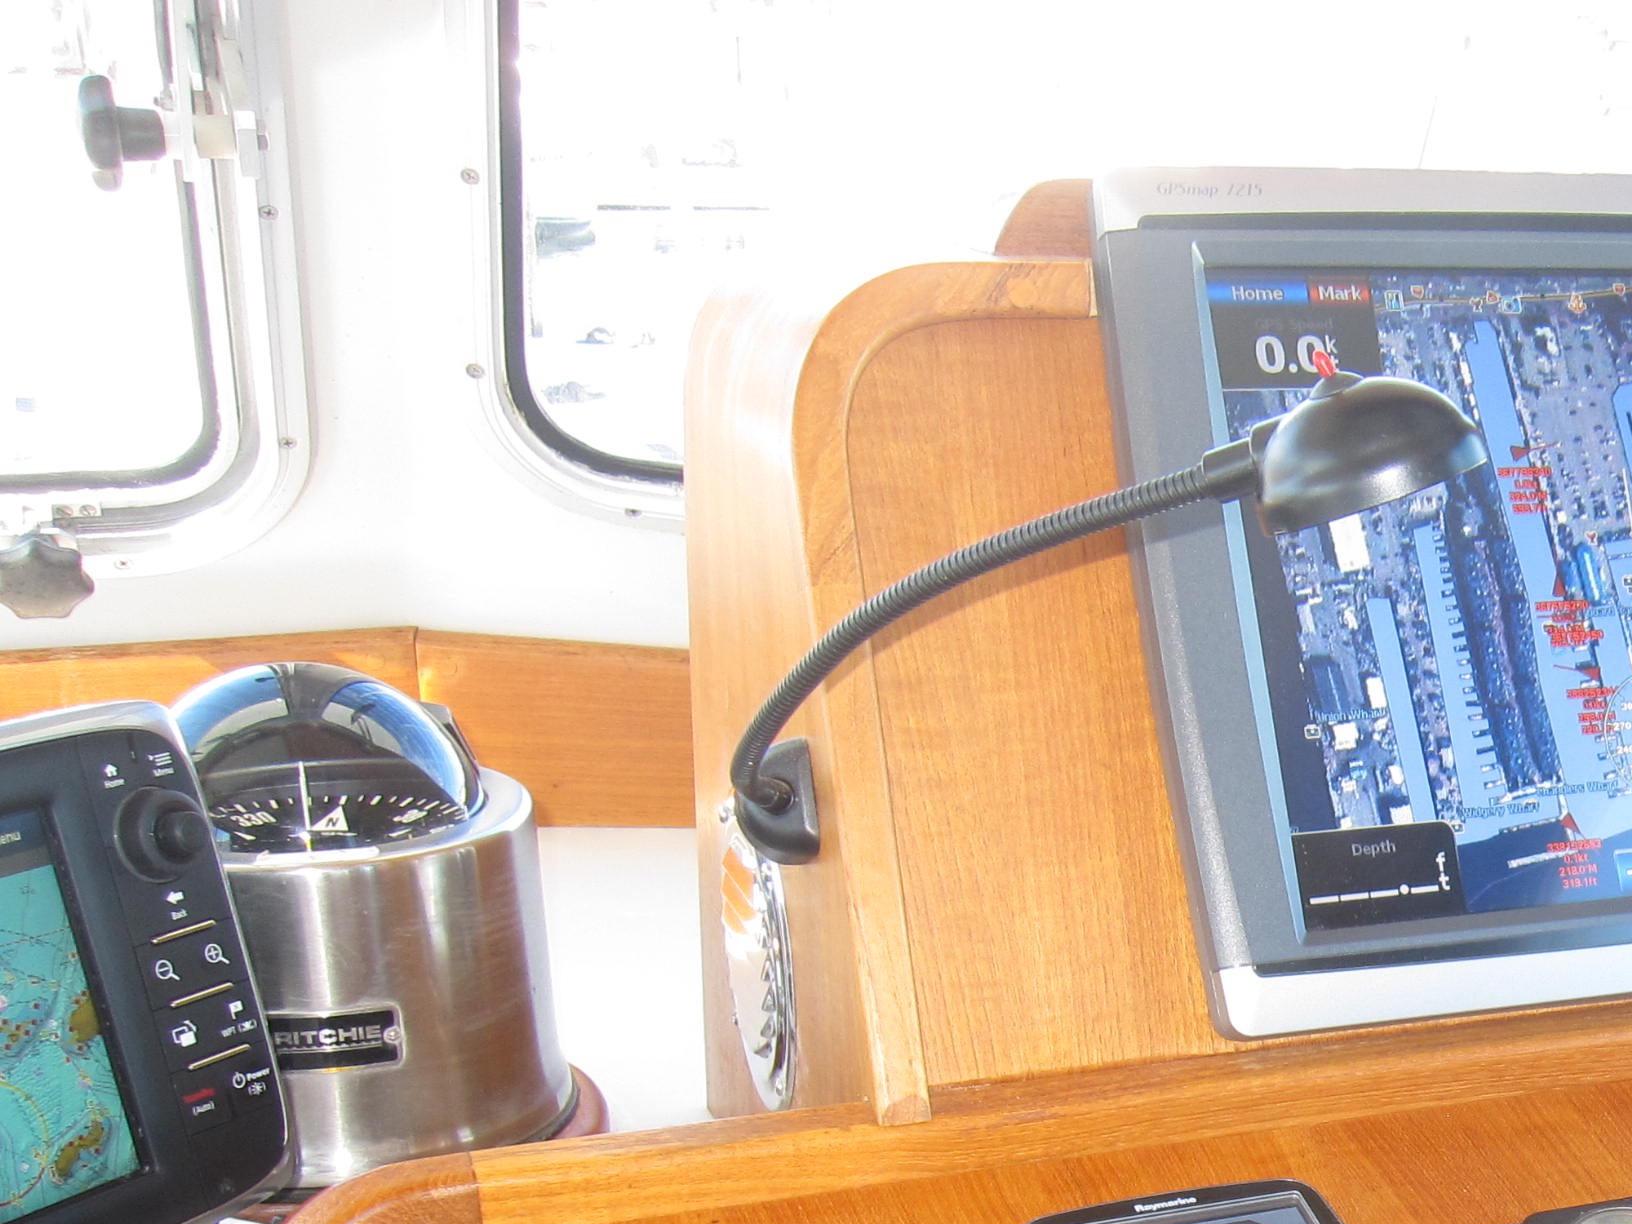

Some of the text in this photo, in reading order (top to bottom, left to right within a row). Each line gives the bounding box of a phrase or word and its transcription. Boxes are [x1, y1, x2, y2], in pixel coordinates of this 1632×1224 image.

[1231, 285, 1284, 301] Home
[1318, 284, 1362, 301] Mark
[1351, 840, 1397, 858] Depth
[274, 1025, 382, 1046] RITCHIE
[1133, 1196, 1198, 1213] Raymarine
